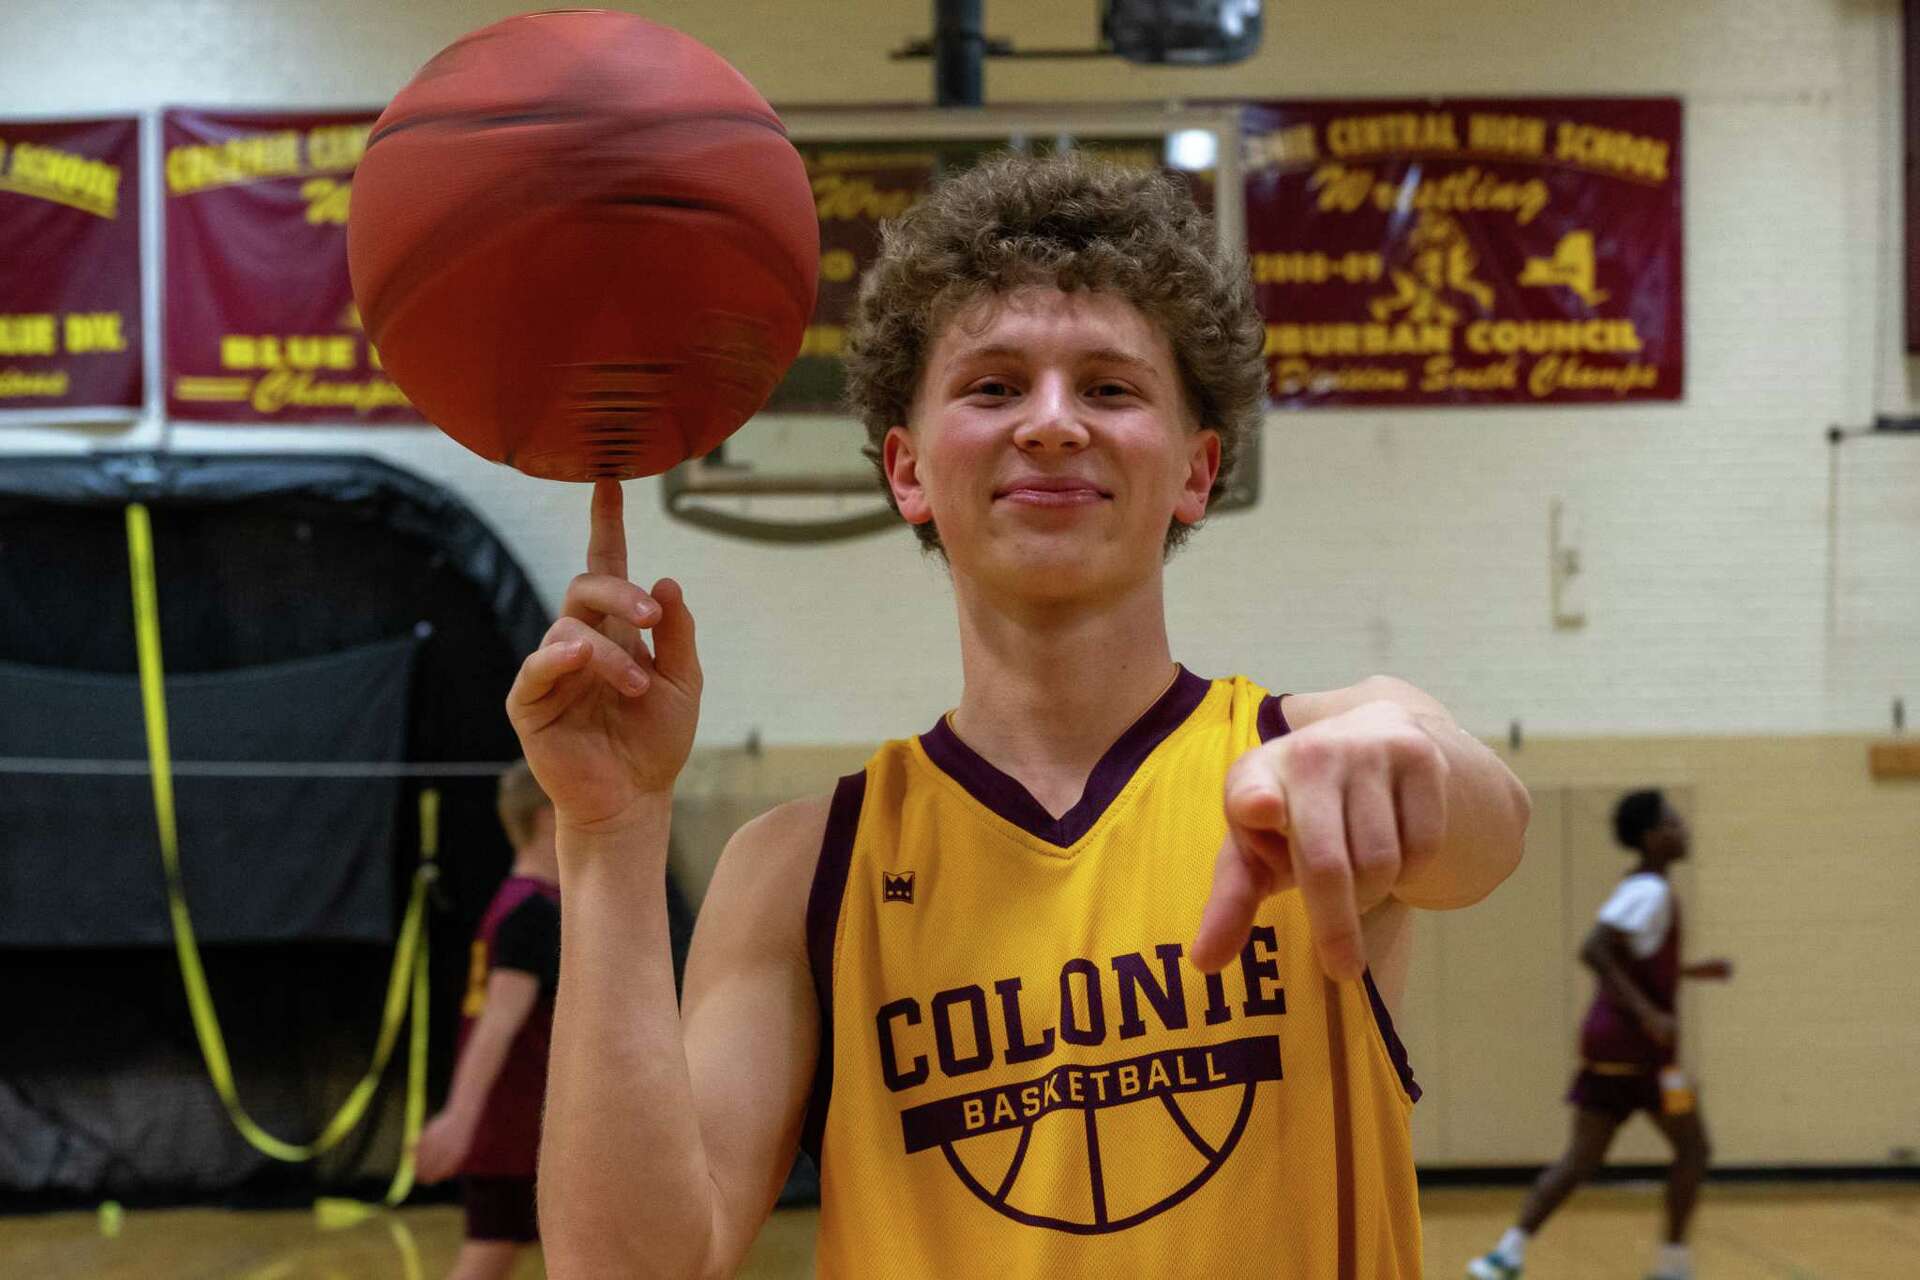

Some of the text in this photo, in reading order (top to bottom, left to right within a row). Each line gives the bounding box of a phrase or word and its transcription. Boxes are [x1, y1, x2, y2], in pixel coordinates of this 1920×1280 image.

[1468, 113, 1546, 153] HIGH
[1555, 121, 1668, 180] SCHOOL
[1311, 167, 1548, 223] Wrstling
[221, 335, 355, 369] BLUE
[1466, 319, 1642, 353] COUNCIL
[876, 926, 1286, 1093] COLONIE
[962, 1052, 1227, 1131] BASKETBALL
